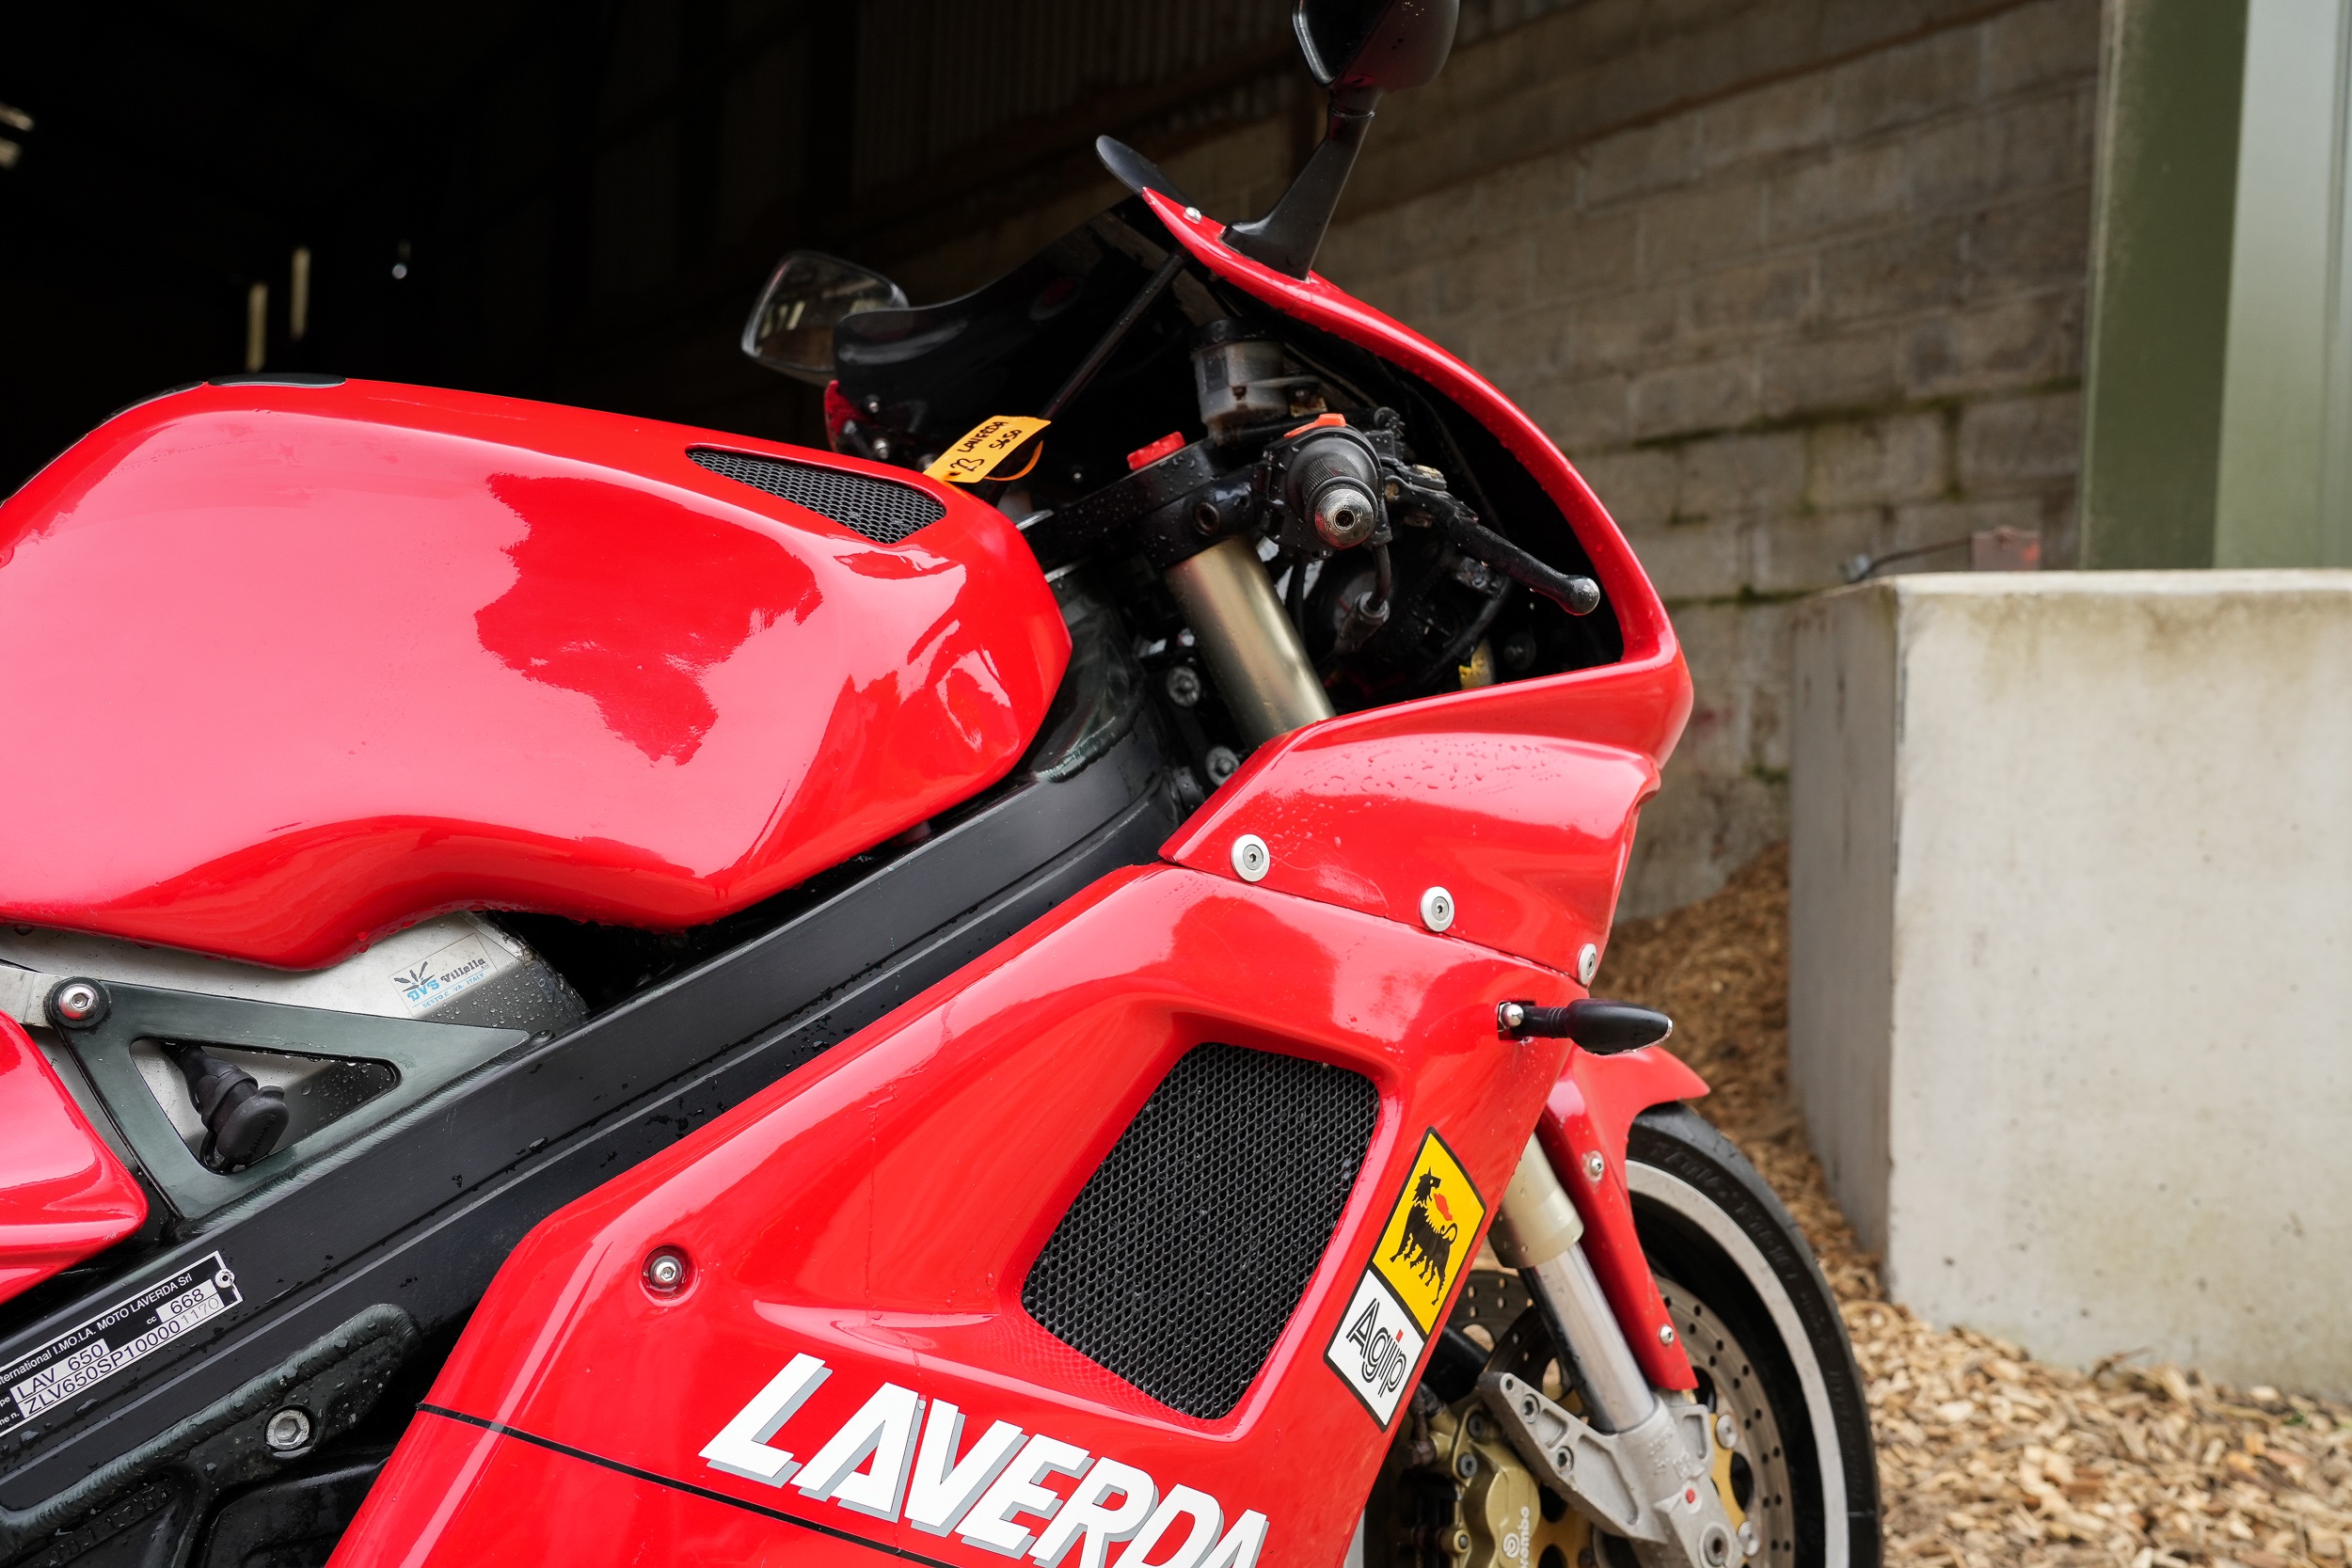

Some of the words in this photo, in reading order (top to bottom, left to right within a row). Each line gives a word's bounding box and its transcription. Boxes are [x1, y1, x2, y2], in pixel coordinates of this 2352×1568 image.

[407, 979, 440, 1002] DVS
[440, 958, 486, 983] Villella
[421, 994, 444, 1008] SESTO
[467, 973, 485, 987] ITALY
[0, 1349, 52, 1386] ternational
[97, 1308, 130, 1331] MOTO
[130, 1281, 178, 1313] LAVERDA
[178, 1273, 193, 1287] Srl
[146, 1316, 157, 1325] cc
[170, 1288, 205, 1314] 668
[17, 1367, 55, 1399] LAV
[68, 1344, 103, 1370] 650
[1345, 1297, 1407, 1399] Agip
